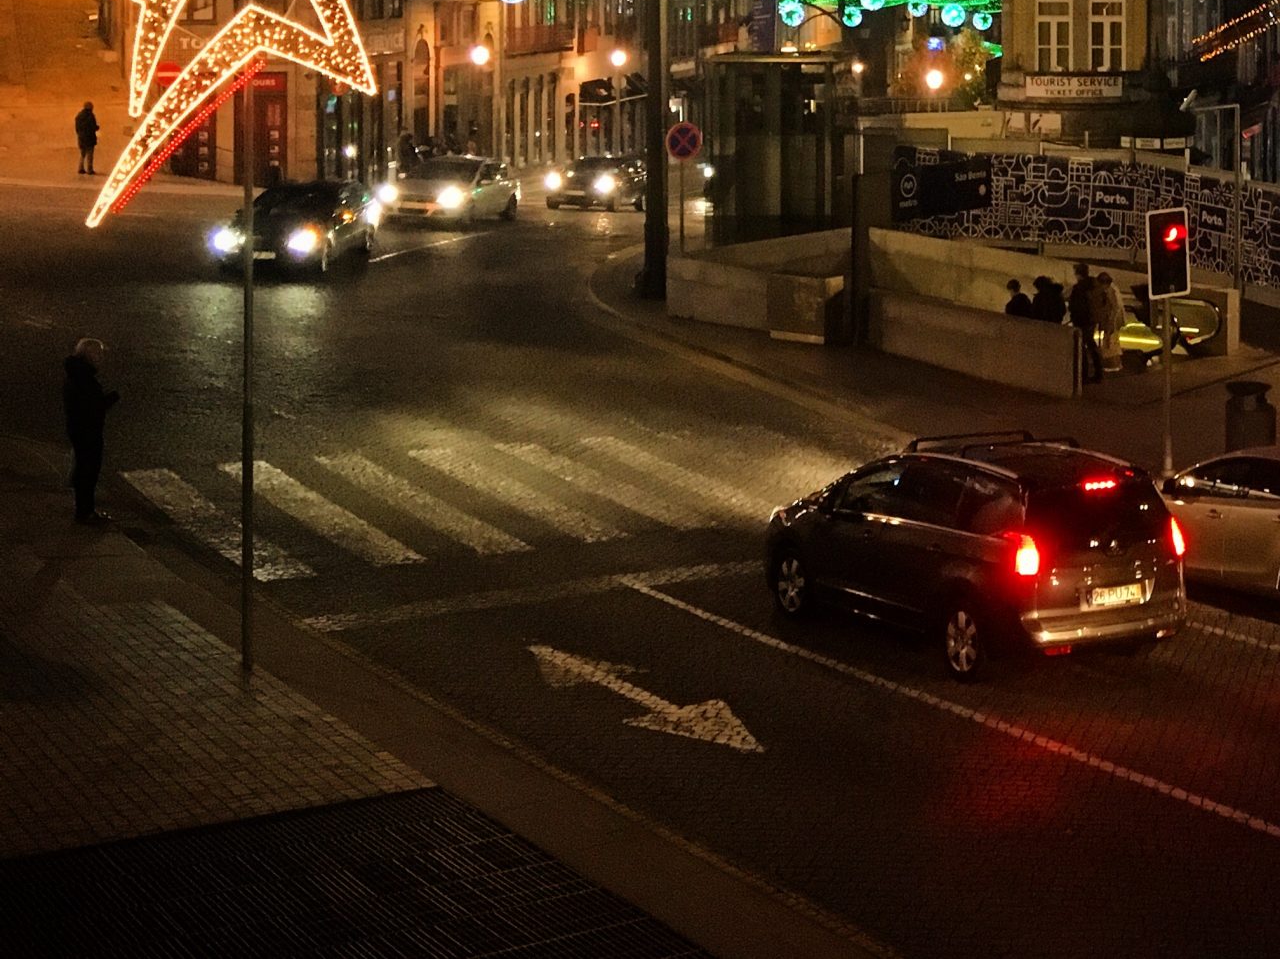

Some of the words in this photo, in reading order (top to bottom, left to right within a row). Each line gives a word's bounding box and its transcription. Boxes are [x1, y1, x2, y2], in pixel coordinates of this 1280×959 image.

[247, 78, 276, 87] OURS
[1030, 76, 1072, 87] TOURIST
[1077, 76, 1119, 87] SERVICE
[1044, 88, 1072, 96] TICKET
[1075, 88, 1104, 96] OFFICE
[1095, 190, 1130, 205] Porto.
[1201, 210, 1224, 226] Porto.
